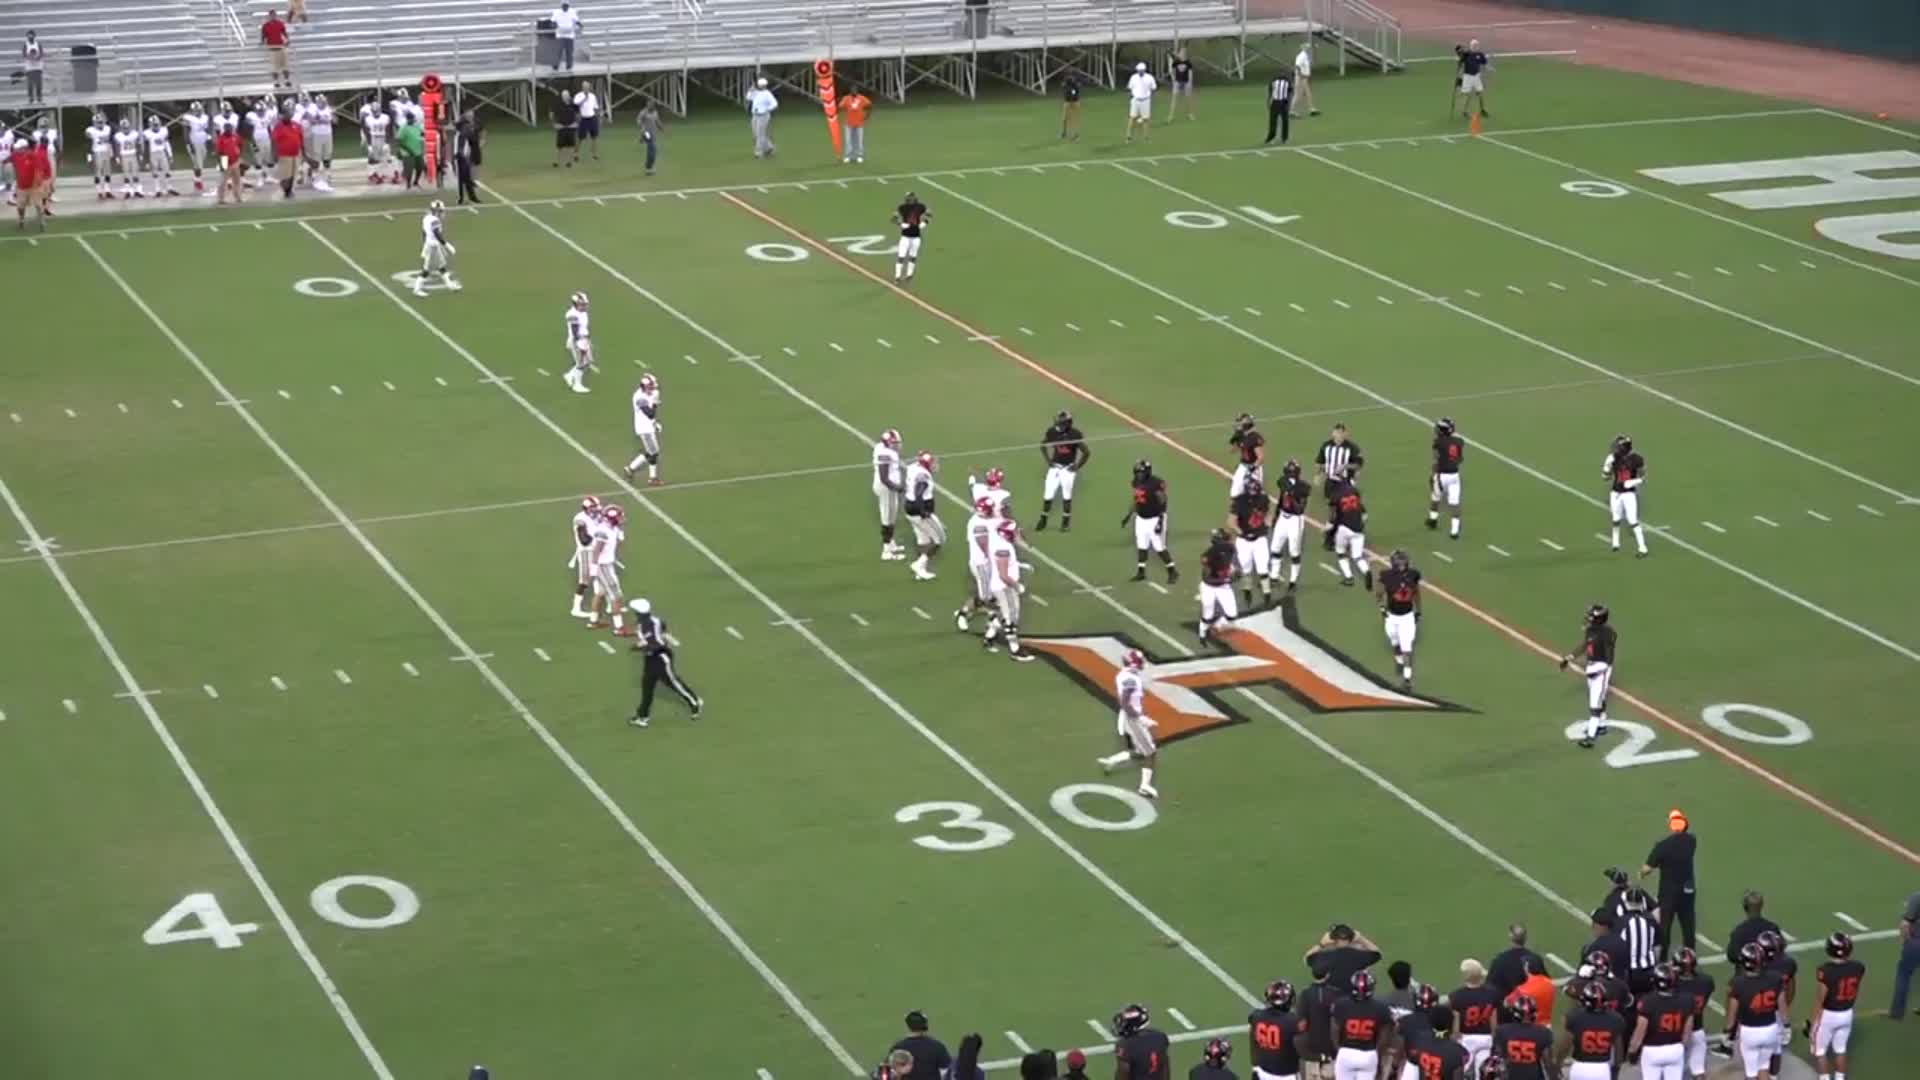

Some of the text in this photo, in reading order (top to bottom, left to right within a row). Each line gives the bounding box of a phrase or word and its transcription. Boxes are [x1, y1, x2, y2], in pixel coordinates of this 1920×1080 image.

[1564, 703, 1814, 769] 20
[894, 783, 1158, 852] 30
[142, 874, 421, 949] 40
[1254, 1021, 1281, 1049] 60
[1506, 1039, 1537, 1064] 55
